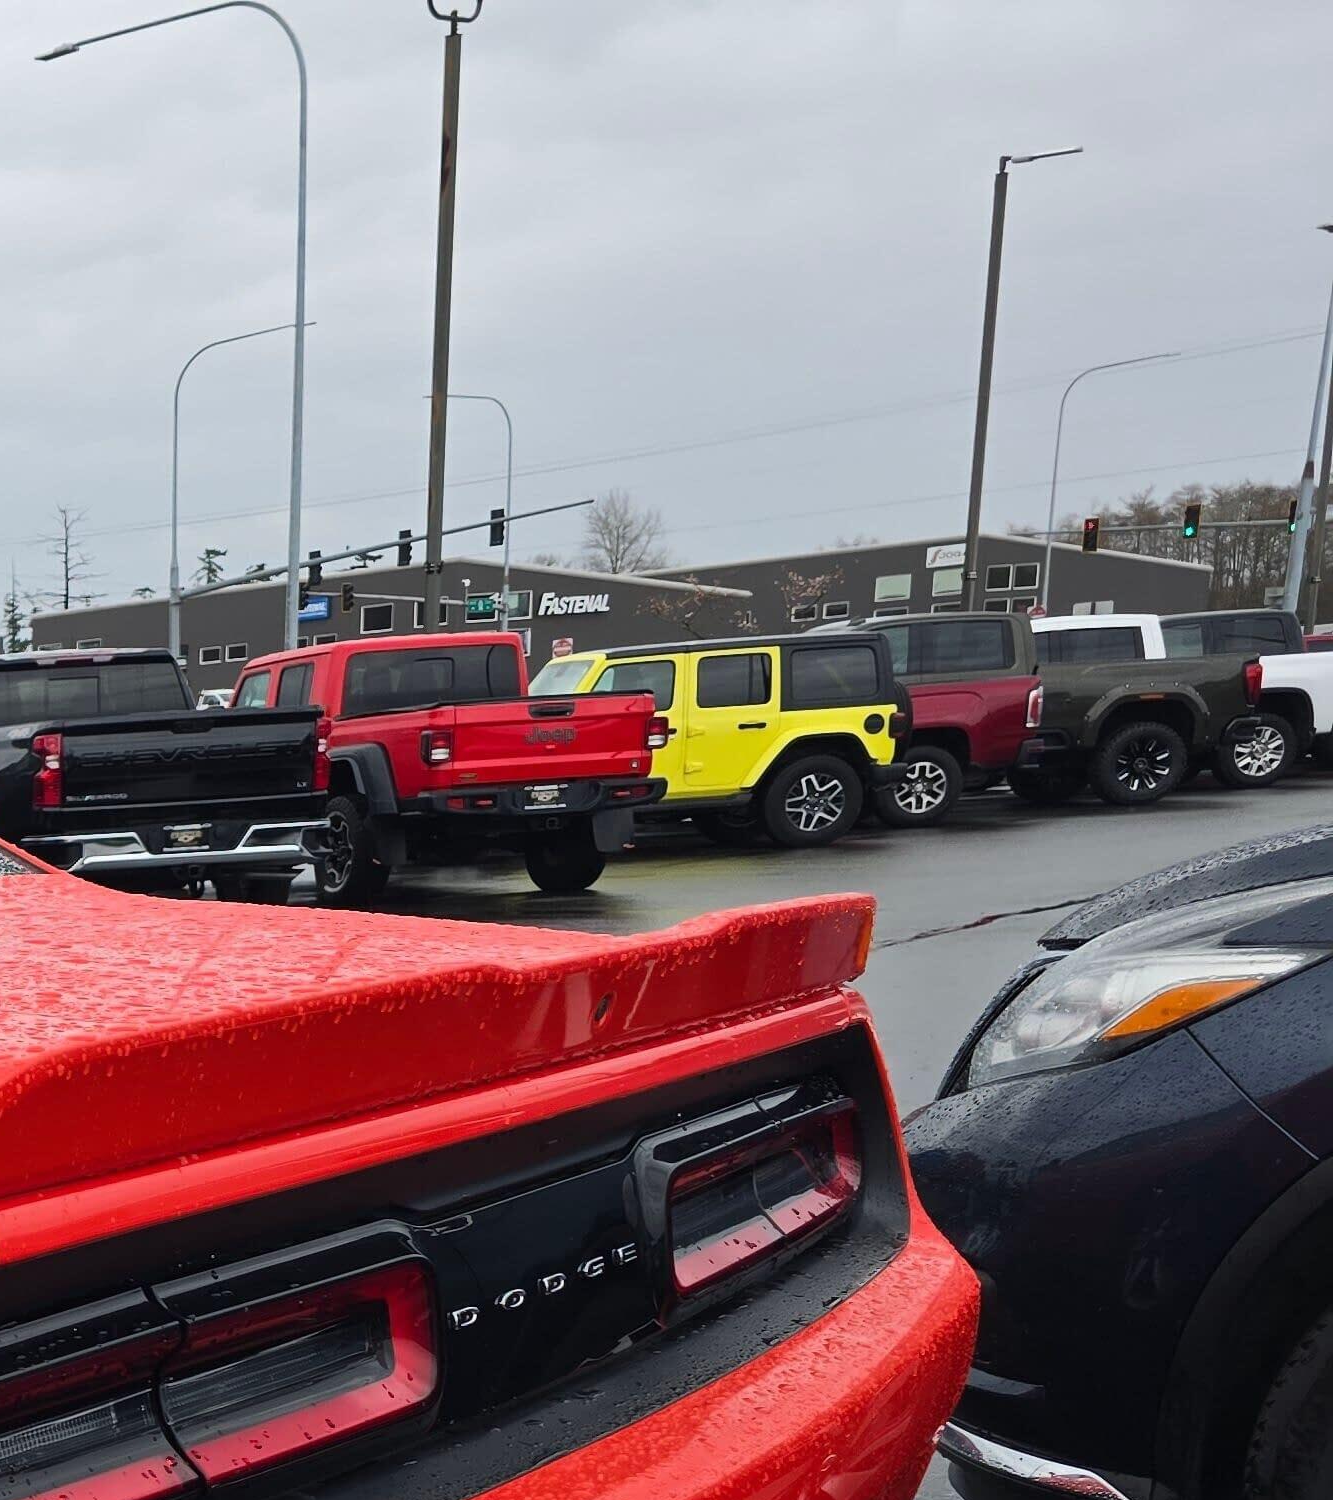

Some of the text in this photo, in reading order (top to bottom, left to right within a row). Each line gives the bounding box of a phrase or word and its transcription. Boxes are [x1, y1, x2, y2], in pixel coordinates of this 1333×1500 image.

[538, 591, 611, 616] FASTENAL
[526, 726, 576, 745] Jeep
[79, 739, 306, 767] CHEVROLET
[446, 1242, 639, 1331] DODGE
